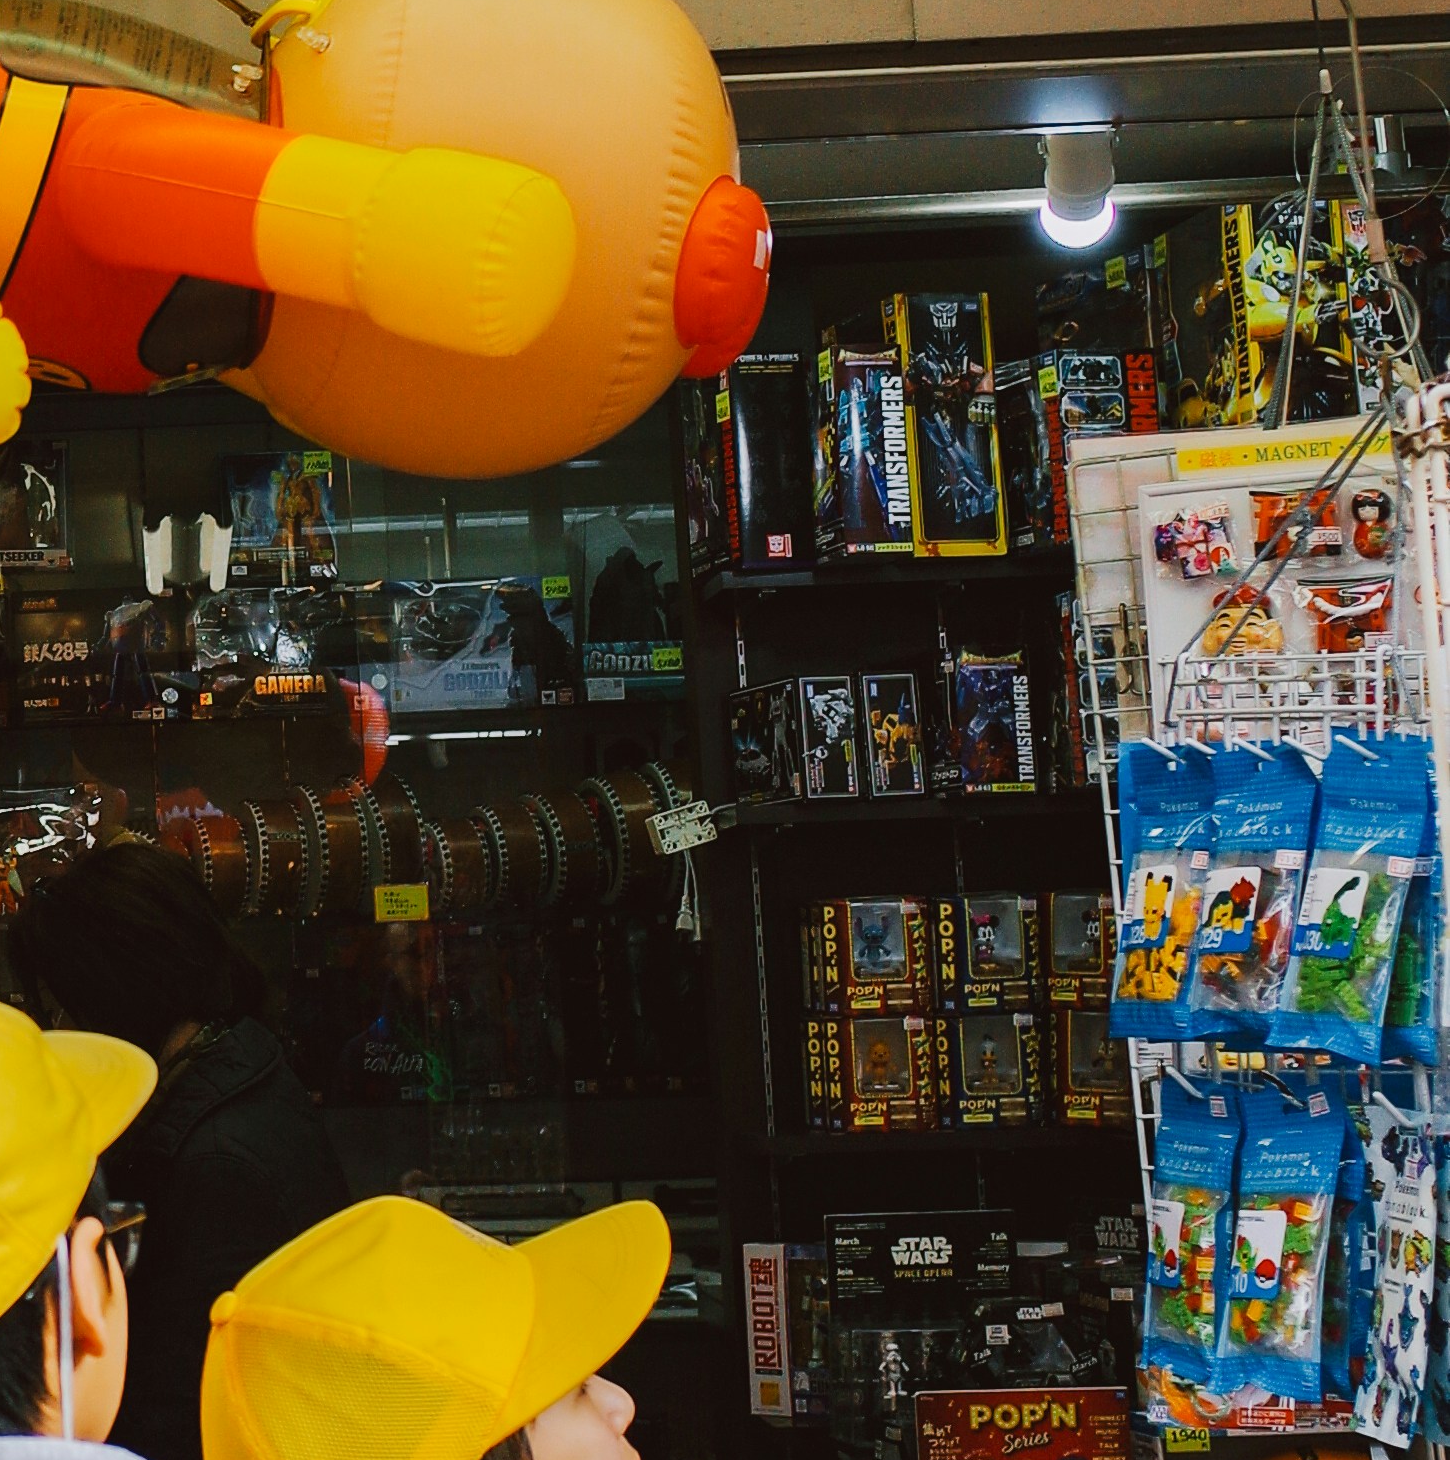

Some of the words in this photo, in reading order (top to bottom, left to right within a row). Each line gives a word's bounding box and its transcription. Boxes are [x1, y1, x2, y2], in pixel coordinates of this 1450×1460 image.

[1222, 217, 1250, 396] TRANSFORMERS
[880, 375, 911, 526] TRANSFORMERS
[1255, 440, 1332, 463] MAGNET
[22, 642, 90, 663] 鉄人28号
[254, 674, 327, 694] GAMERA
[1012, 675, 1036, 782] TRANSFORMERS
[1094, 1215, 1138, 1232] STAR
[891, 1236, 953, 1252] STAR
[1095, 1231, 1139, 1247] WARS
[892, 1250, 953, 1266] WARS
[977, 1263, 1010, 1273] Memory
[1001, 1430, 1050, 1455] Series
[1171, 1429, 1207, 1443] 1940
